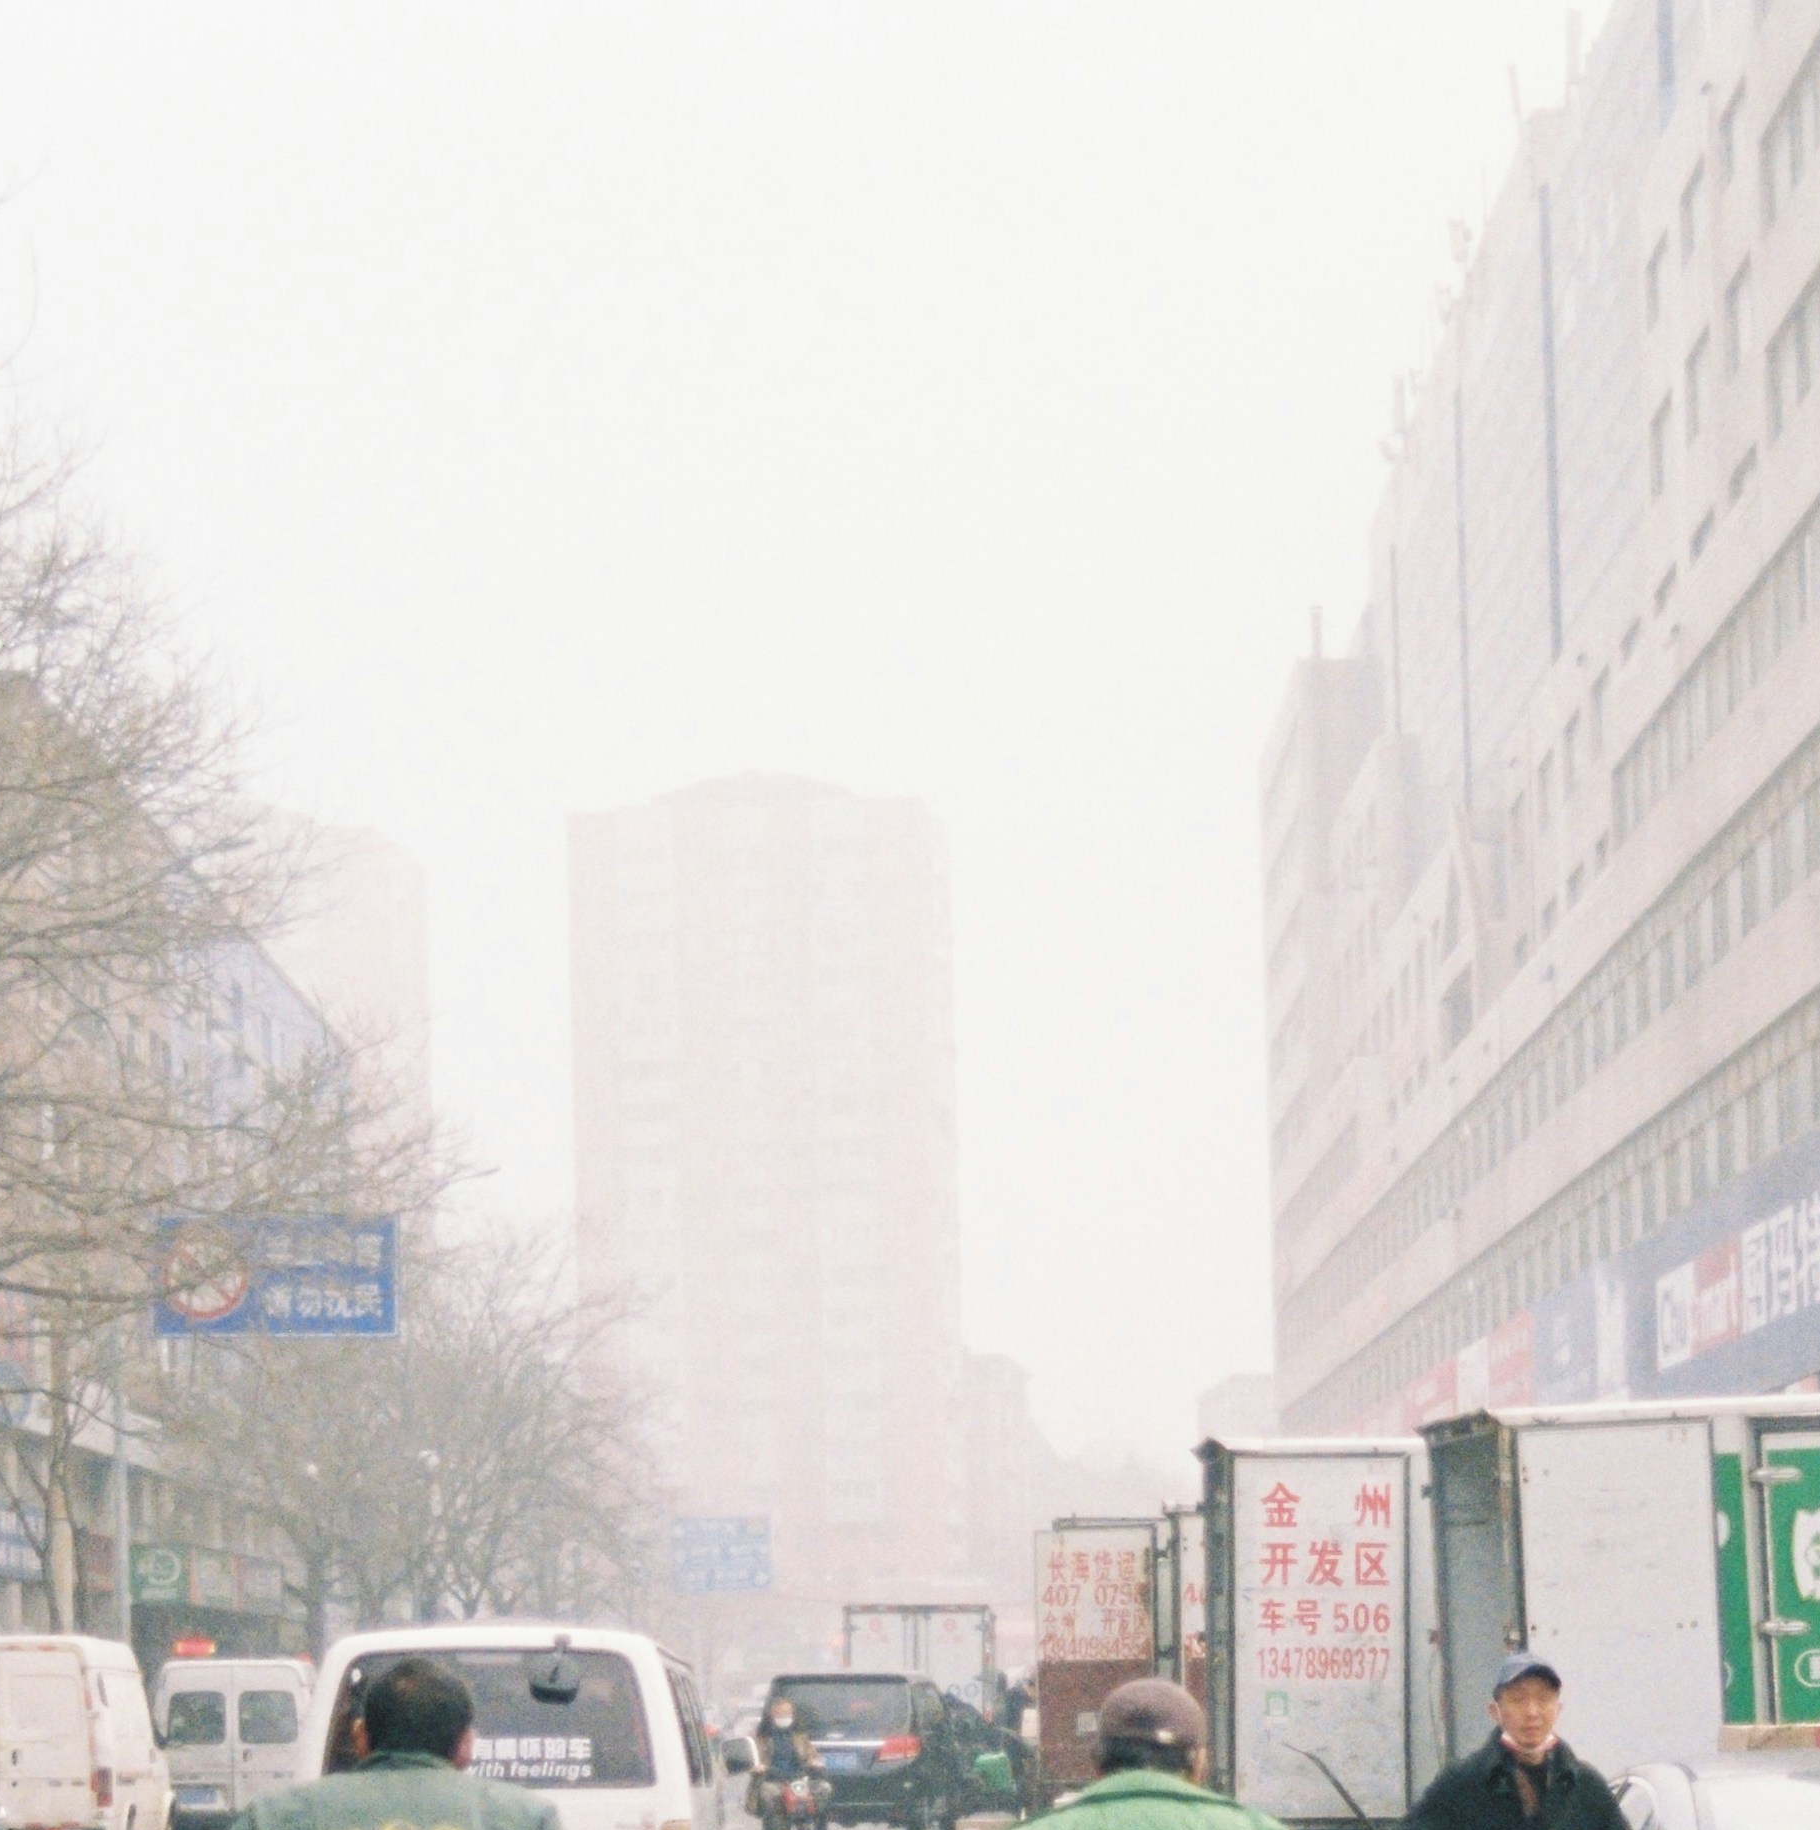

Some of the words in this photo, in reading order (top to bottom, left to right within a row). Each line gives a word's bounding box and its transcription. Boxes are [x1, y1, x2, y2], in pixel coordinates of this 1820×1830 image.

[1258, 1540, 1391, 1588] 开发区
[1257, 1647, 1392, 1681] 13478969377
[509, 1760, 592, 1782] feelings
